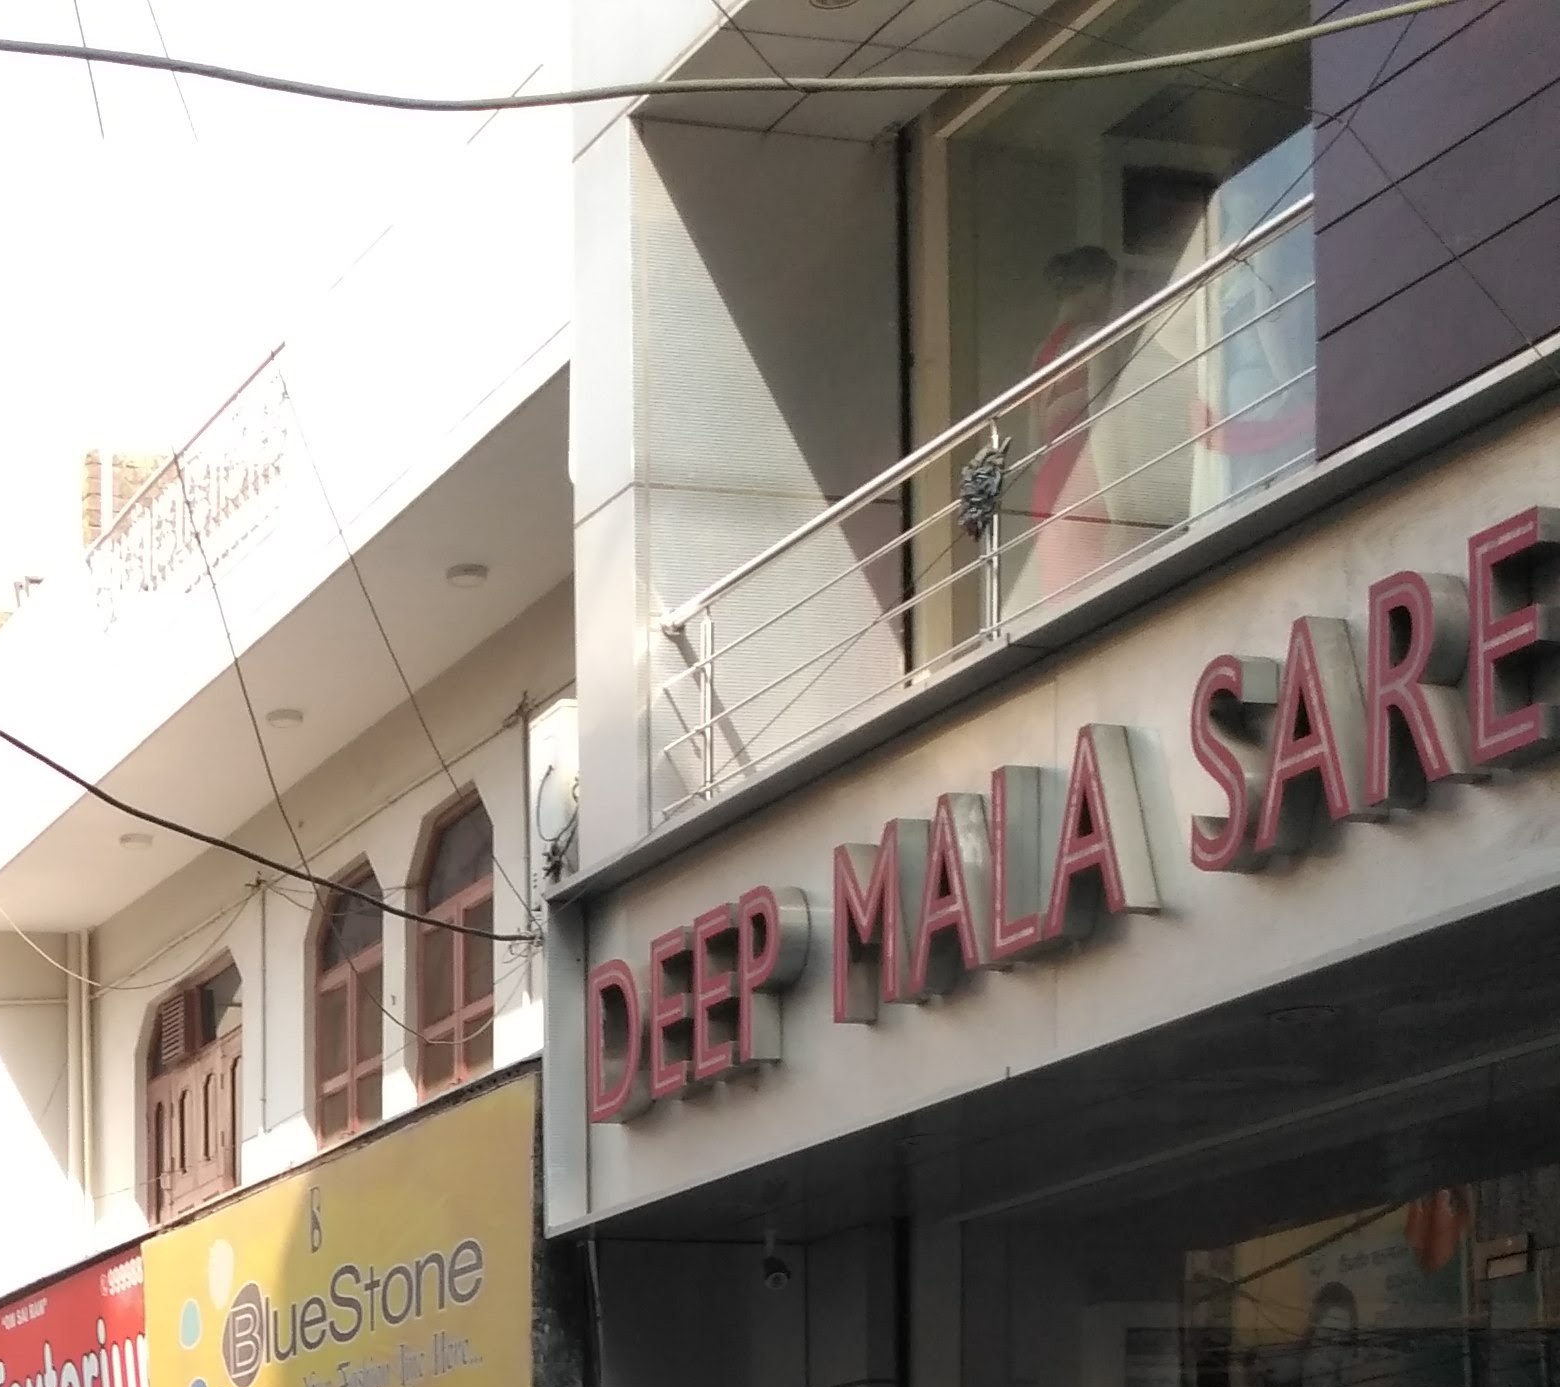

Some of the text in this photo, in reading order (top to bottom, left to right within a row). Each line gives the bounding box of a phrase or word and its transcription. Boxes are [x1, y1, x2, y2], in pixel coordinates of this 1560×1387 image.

[588, 506, 1556, 1124] DEEP MALA SARE
[230, 1239, 484, 1381] BlueStone
